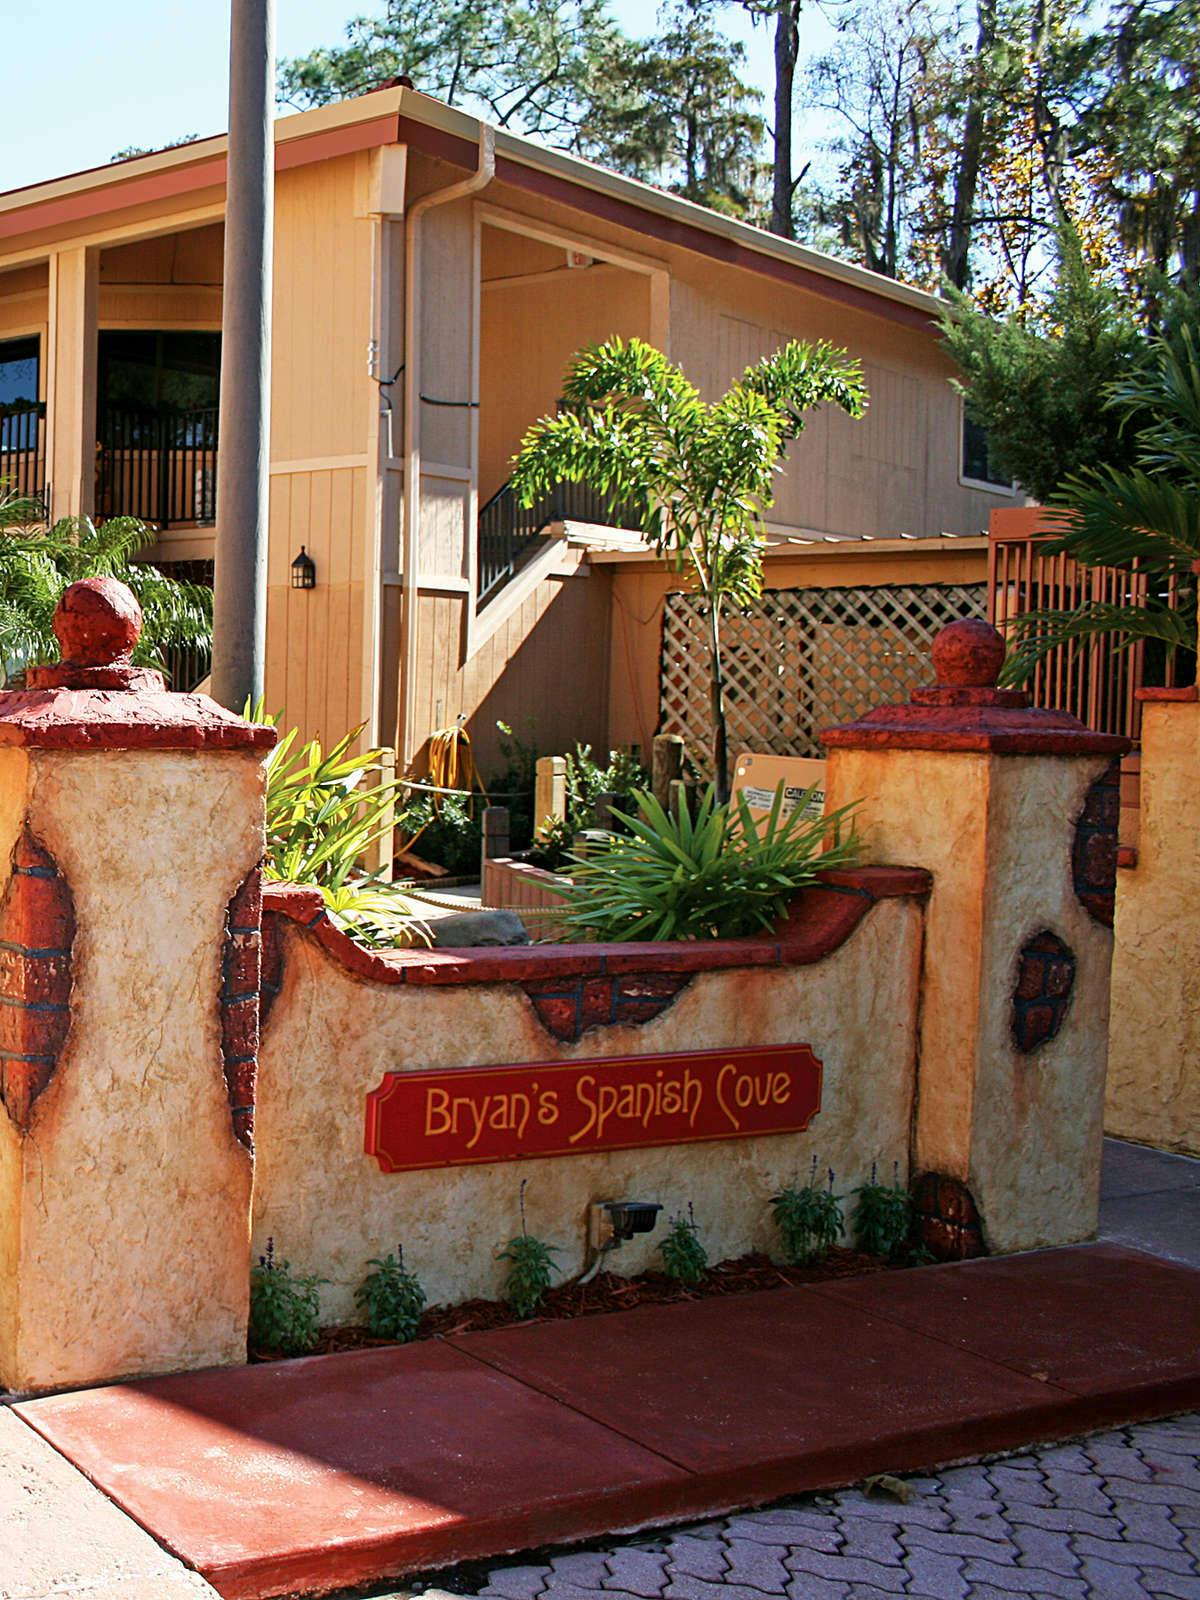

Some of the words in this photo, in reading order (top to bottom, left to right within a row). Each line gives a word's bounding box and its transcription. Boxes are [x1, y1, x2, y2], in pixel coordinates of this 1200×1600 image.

[785, 788, 825, 802] CAUON
[425, 1084, 559, 1148] Bryan's
[569, 1070, 701, 1143] Spanish
[717, 1064, 791, 1130] Cove
